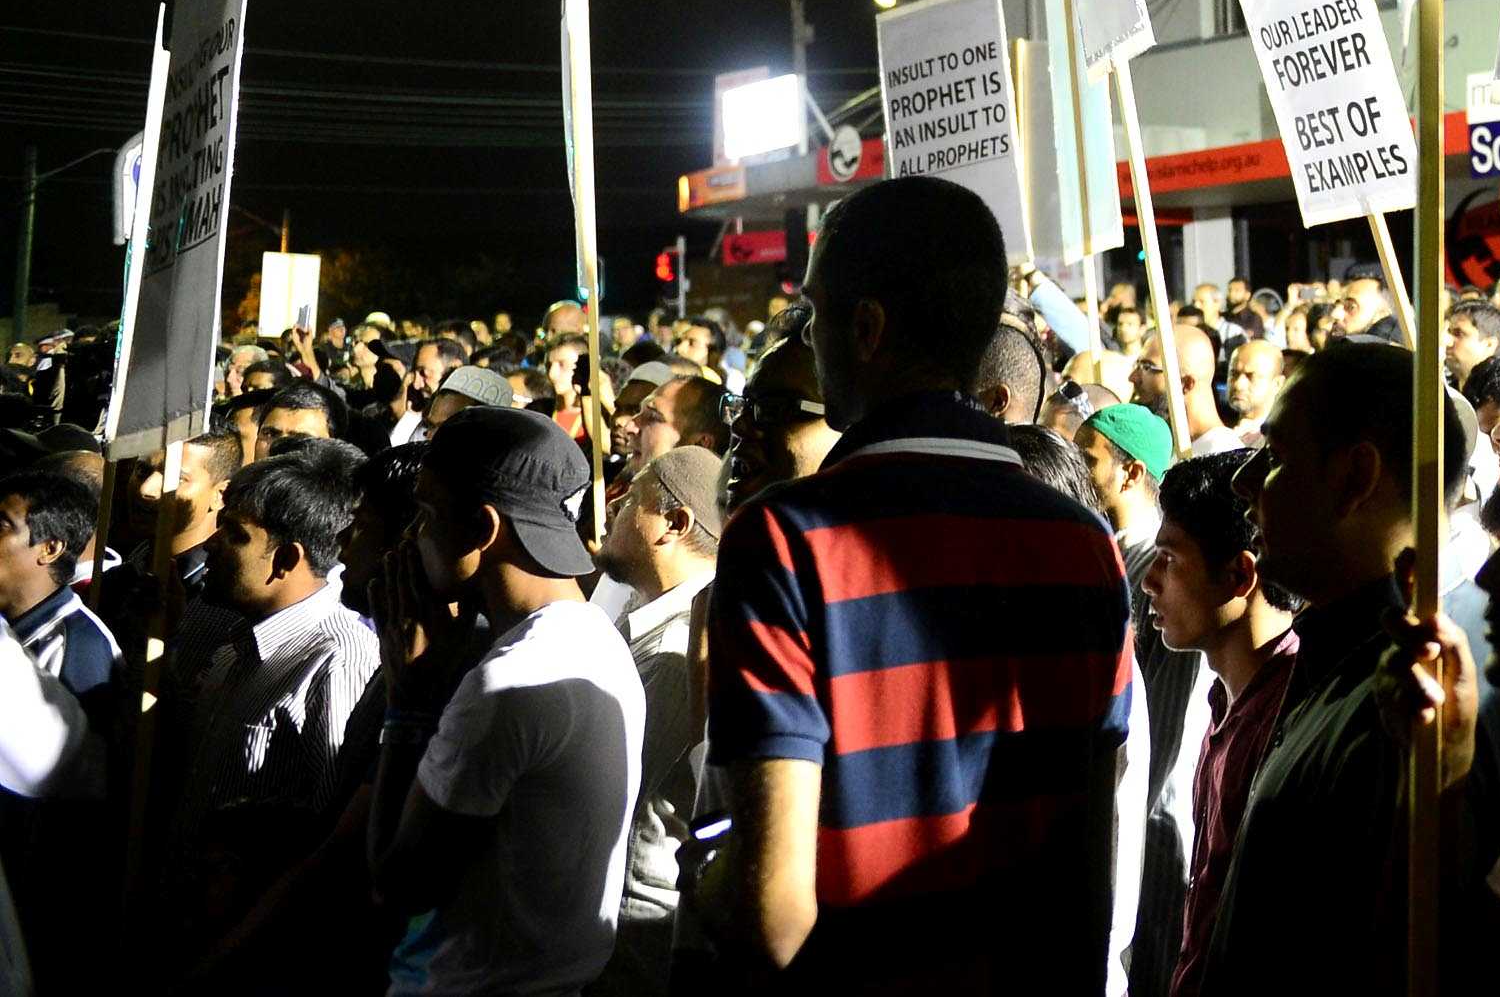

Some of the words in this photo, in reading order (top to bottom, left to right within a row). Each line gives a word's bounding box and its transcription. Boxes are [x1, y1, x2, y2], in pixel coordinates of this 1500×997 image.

[1260, 18, 1293, 51] OUR
[888, 58, 935, 89] INSULT
[937, 52, 958, 72] TO
[962, 41, 997, 66] ONE
[1273, 32, 1371, 91] FOREVER
[891, 77, 976, 121] PROPHET
[983, 71, 1001, 96] IS
[895, 126, 916, 149] AN
[919, 109, 978, 143] INSULT
[982, 104, 1006, 126] TO
[1294, 107, 1344, 151] BEST
[1347, 97, 1381, 138] OF
[900, 156, 924, 177] ALL
[928, 134, 1009, 171] PROPHETS
[1304, 144, 1408, 193] EXAMPLES
